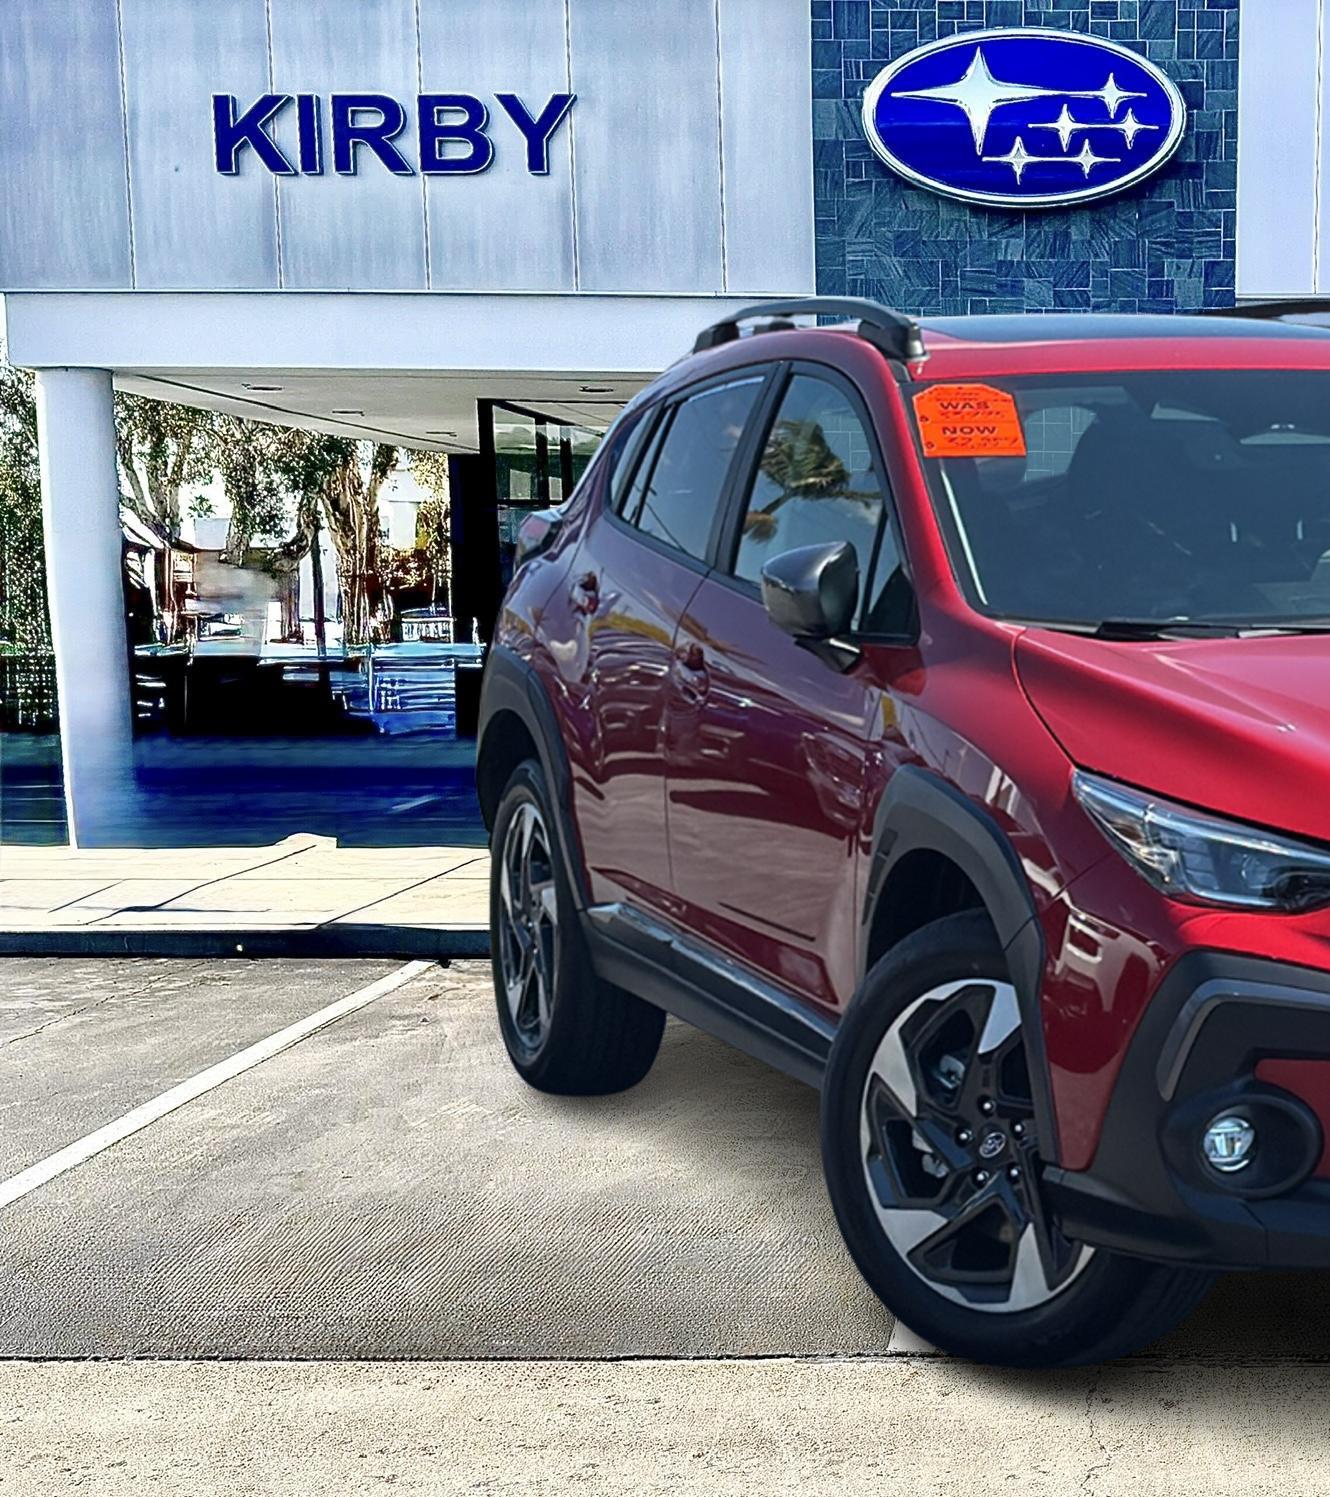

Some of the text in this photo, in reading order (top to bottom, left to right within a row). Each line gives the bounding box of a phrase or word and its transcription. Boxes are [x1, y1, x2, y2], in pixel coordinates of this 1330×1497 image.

[212, 93, 578, 175] KIRBY
[939, 401, 991, 411] WAS
[942, 425, 997, 436] NOW
